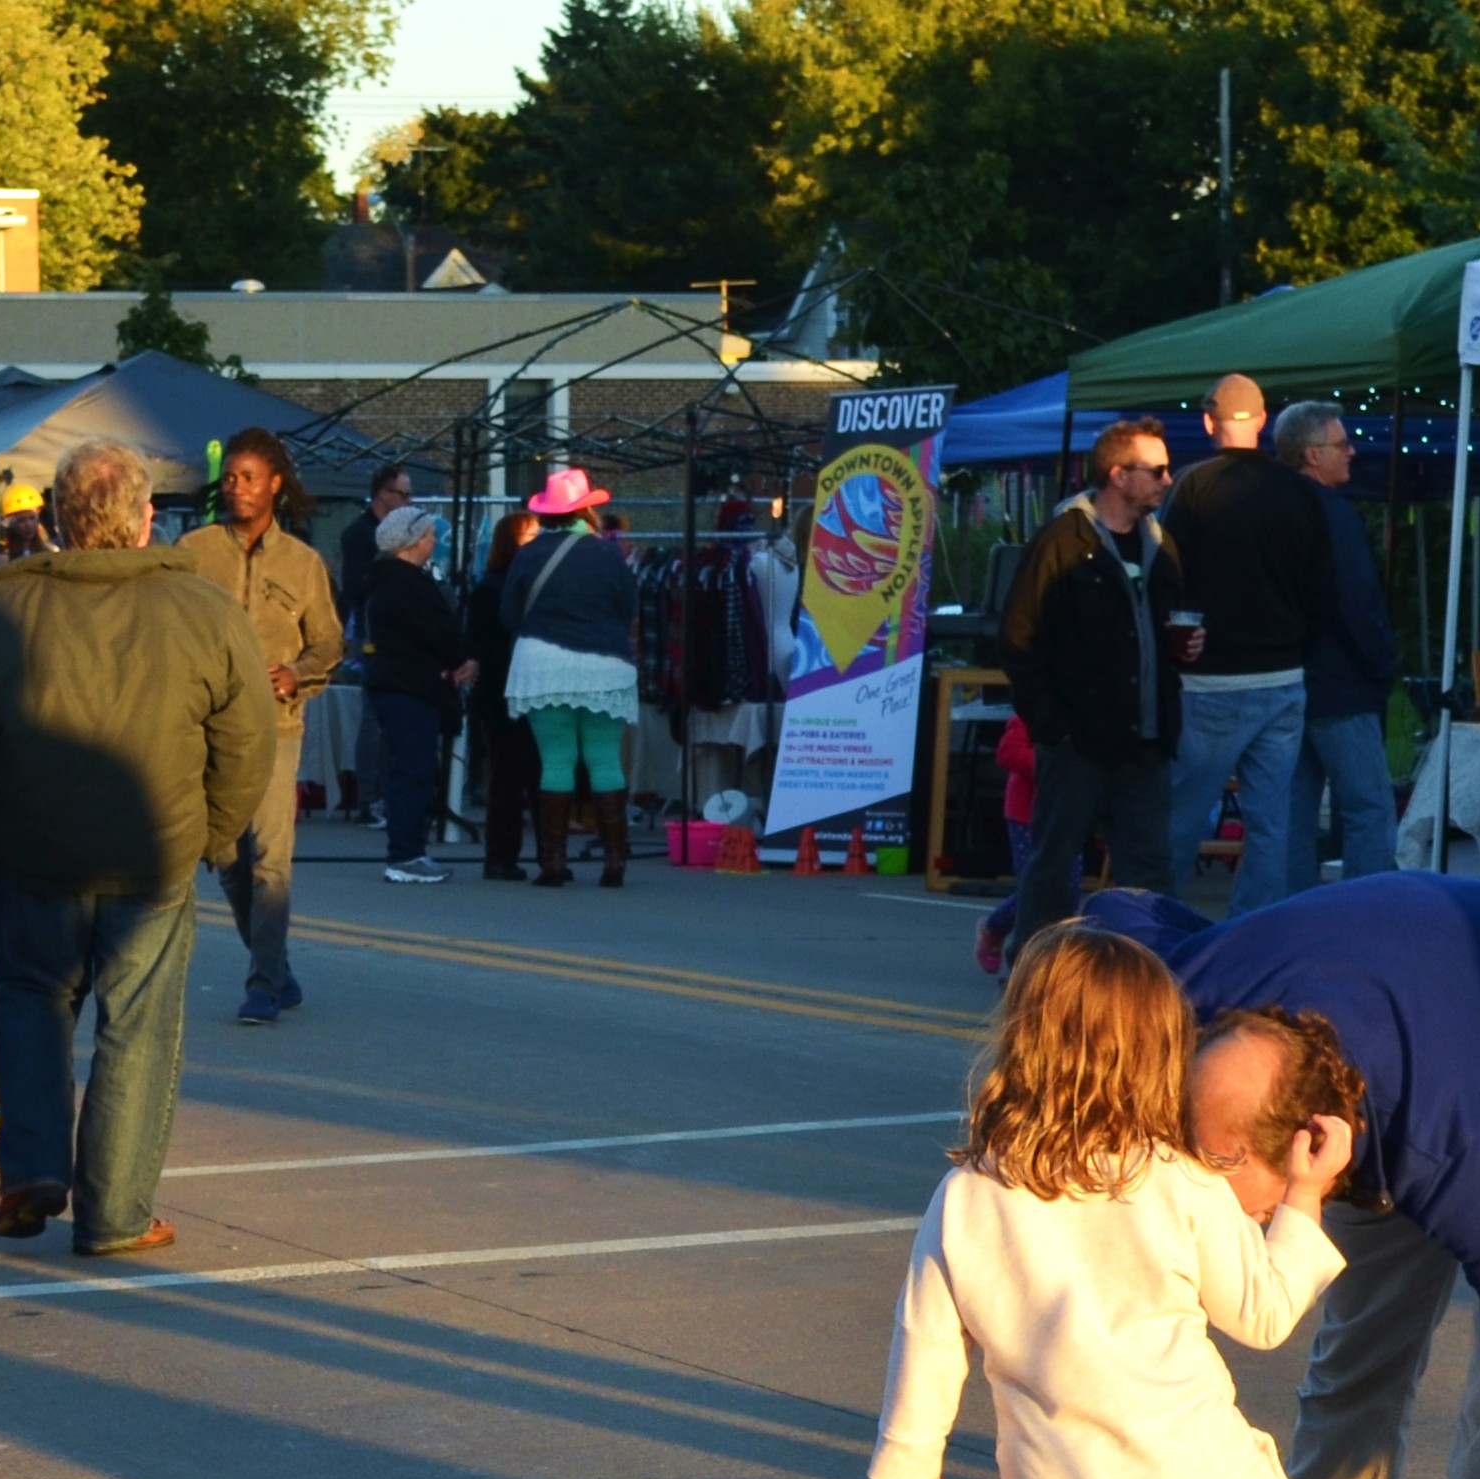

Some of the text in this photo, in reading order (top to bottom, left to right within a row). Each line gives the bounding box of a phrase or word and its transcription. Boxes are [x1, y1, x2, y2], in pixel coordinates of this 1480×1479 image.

[837, 393, 945, 434] DISCOVER
[821, 453, 921, 604] DOWNTOWN APPLETON
[855, 667, 918, 705] One Great
[880, 686, 914, 717] Place!
[833, 718, 858, 727] SHOPS
[800, 731, 820, 740] PUBS
[829, 731, 867, 740] EATERIES
[798, 744, 815, 753] LIVE
[817, 744, 841, 753] MUSIC
[843, 745, 874, 754] VENUES
[796, 757, 849, 766] ATTRACTIONS
[858, 758, 895, 767] MUSEUMS
[804, 781, 834, 790] EVENTS
